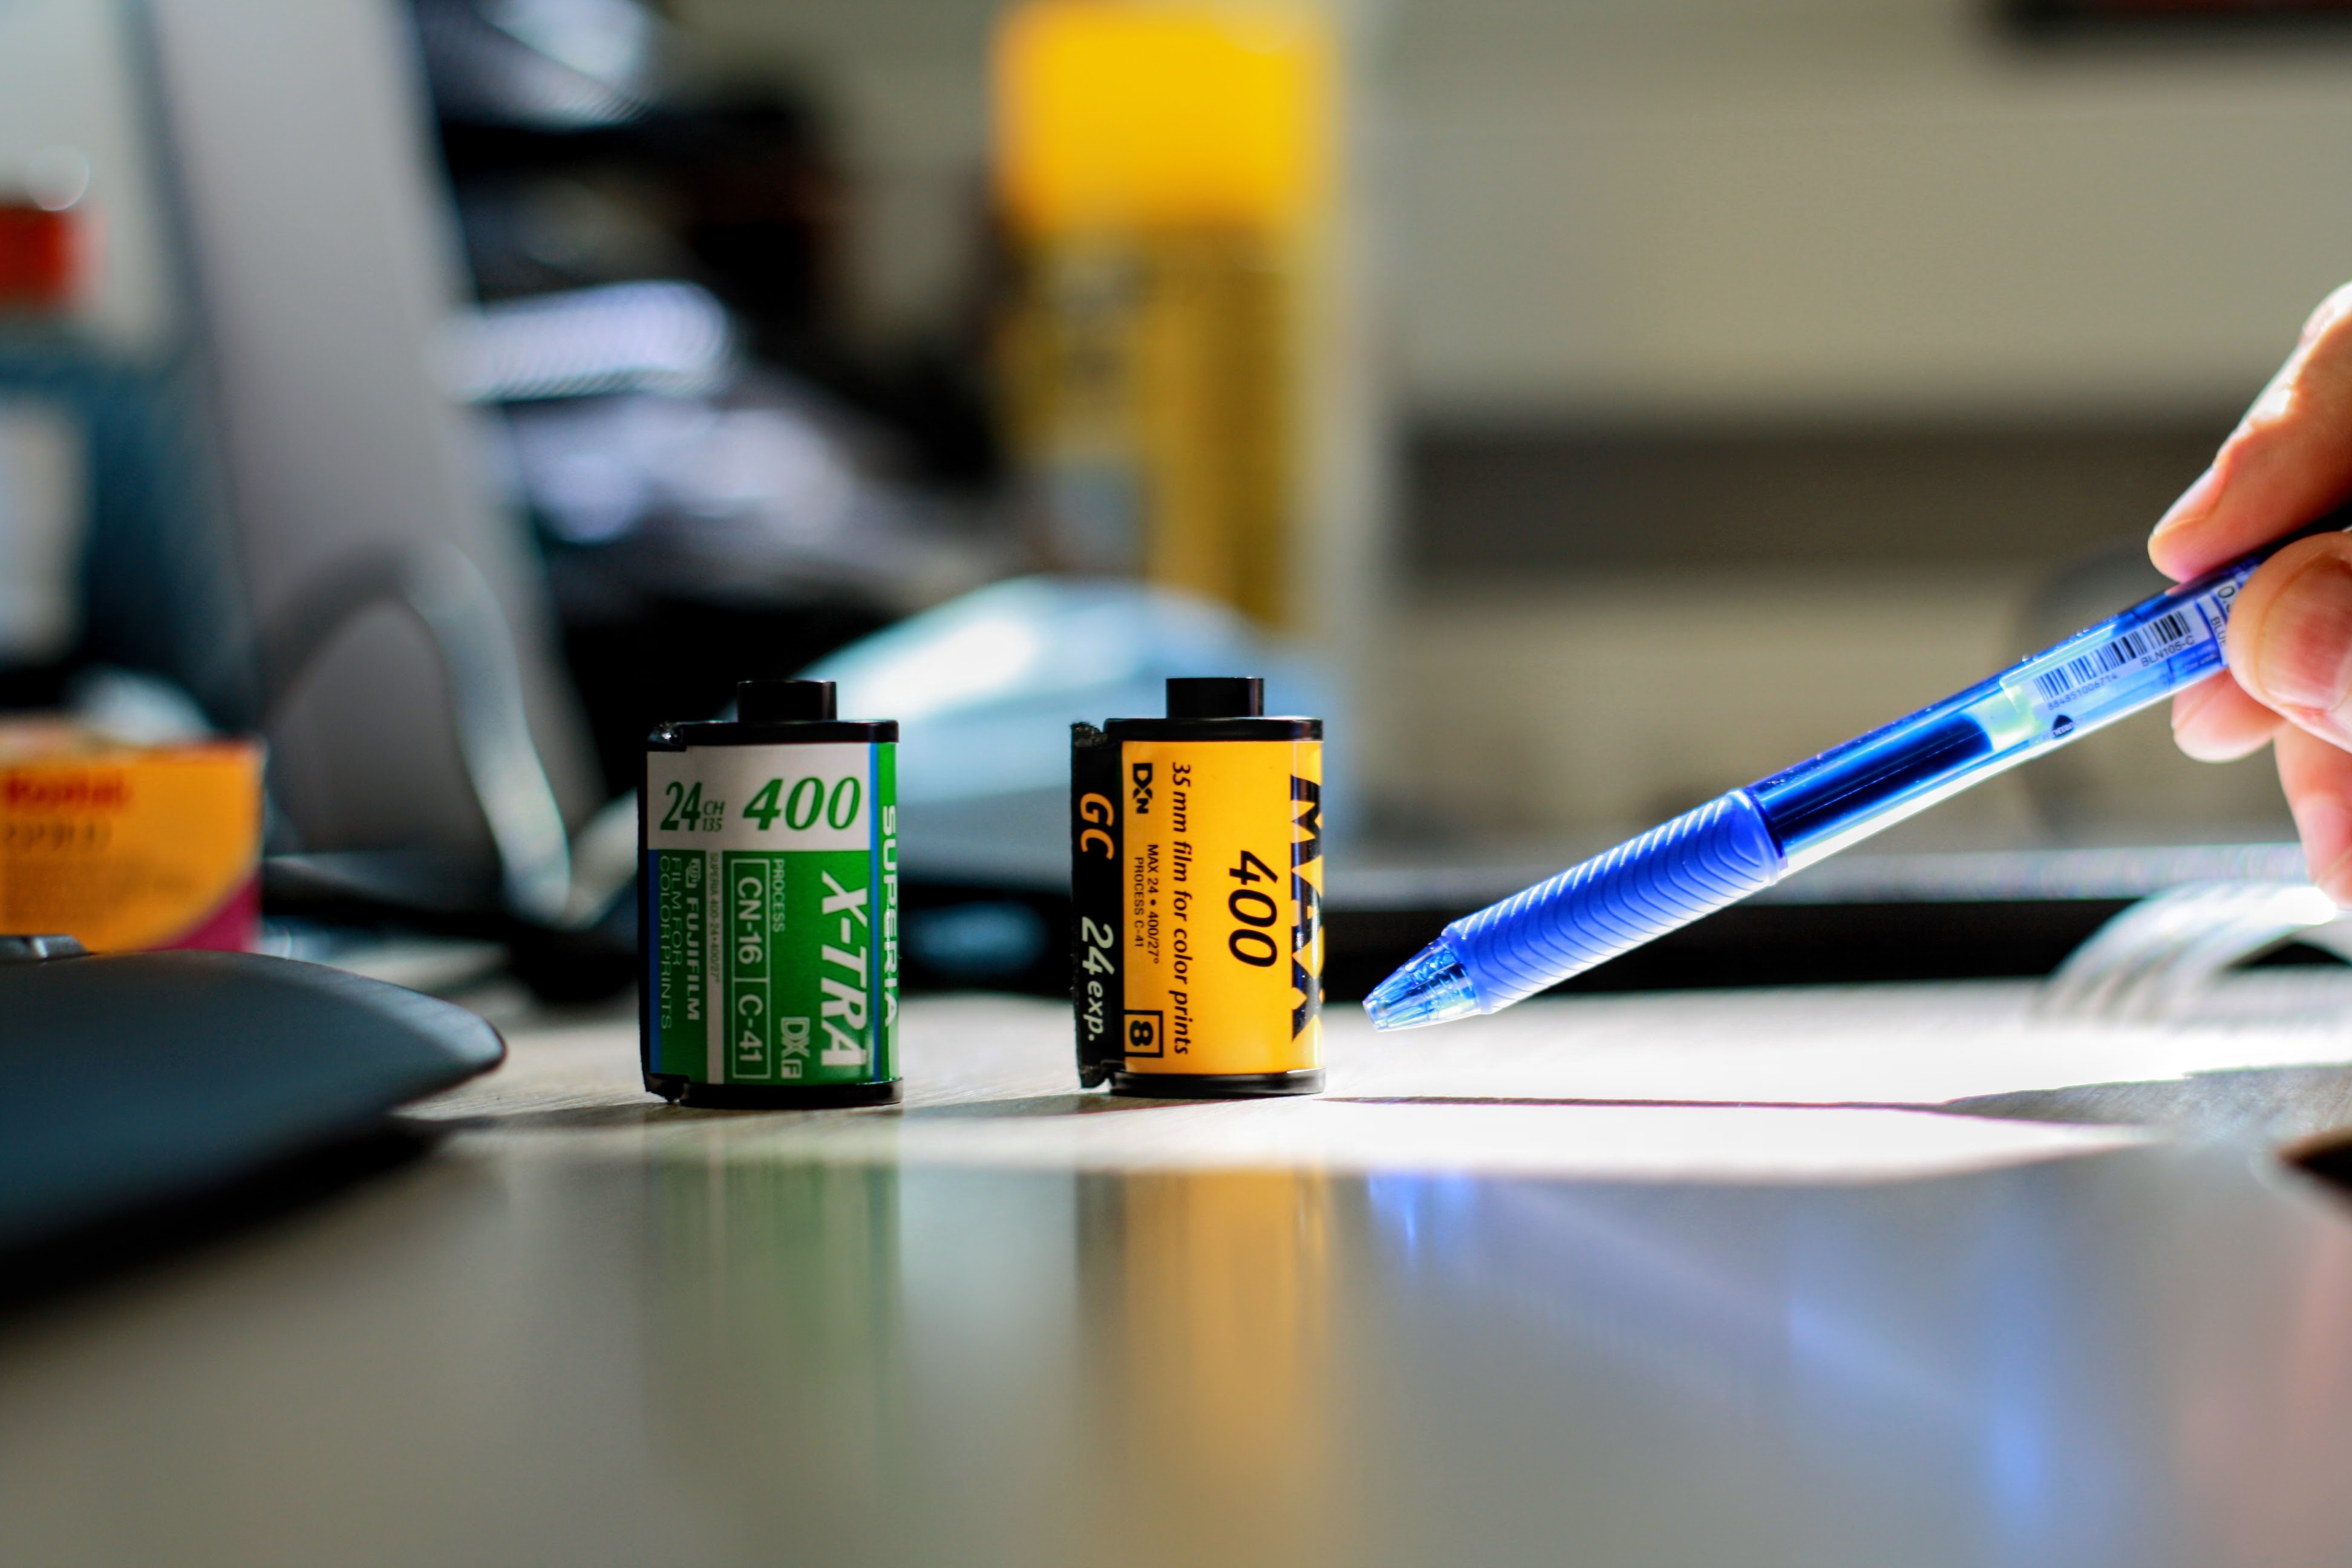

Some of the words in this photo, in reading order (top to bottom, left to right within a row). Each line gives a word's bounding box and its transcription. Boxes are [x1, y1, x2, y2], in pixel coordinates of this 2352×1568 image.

[660, 782, 702, 832] 24
[703, 800, 725, 816] CH
[742, 777, 861, 832] 400
[702, 817, 723, 832] 135
[1079, 792, 1115, 860] GC
[671, 857, 682, 910] FILM
[1134, 857, 1145, 915] PROCESS
[1147, 844, 1160, 876] MAX
[1147, 880, 1159, 896] 24
[1173, 840, 1193, 883] film
[660, 855, 671, 939] COLOR
[737, 877, 763, 965] CN-16
[772, 858, 785, 933] PROCESS
[882, 805, 899, 1028] SUPERIA
[1174, 886, 1193, 922] for
[1227, 849, 1278, 968] 400
[1290, 774, 1324, 1043] MAX
[671, 917, 683, 965] FOR
[687, 897, 700, 1020] FUJIFILM
[1082, 916, 1114, 975] 24
[1134, 920, 1145, 948] C-41
[1173, 927, 1193, 985] color
[661, 945, 672, 1029] PRINTS
[821, 871, 868, 1067] X-TRA
[738, 993, 763, 1063] C-41
[1083, 980, 1104, 1042] exp.
[1168, 990, 1191, 1056] prints
